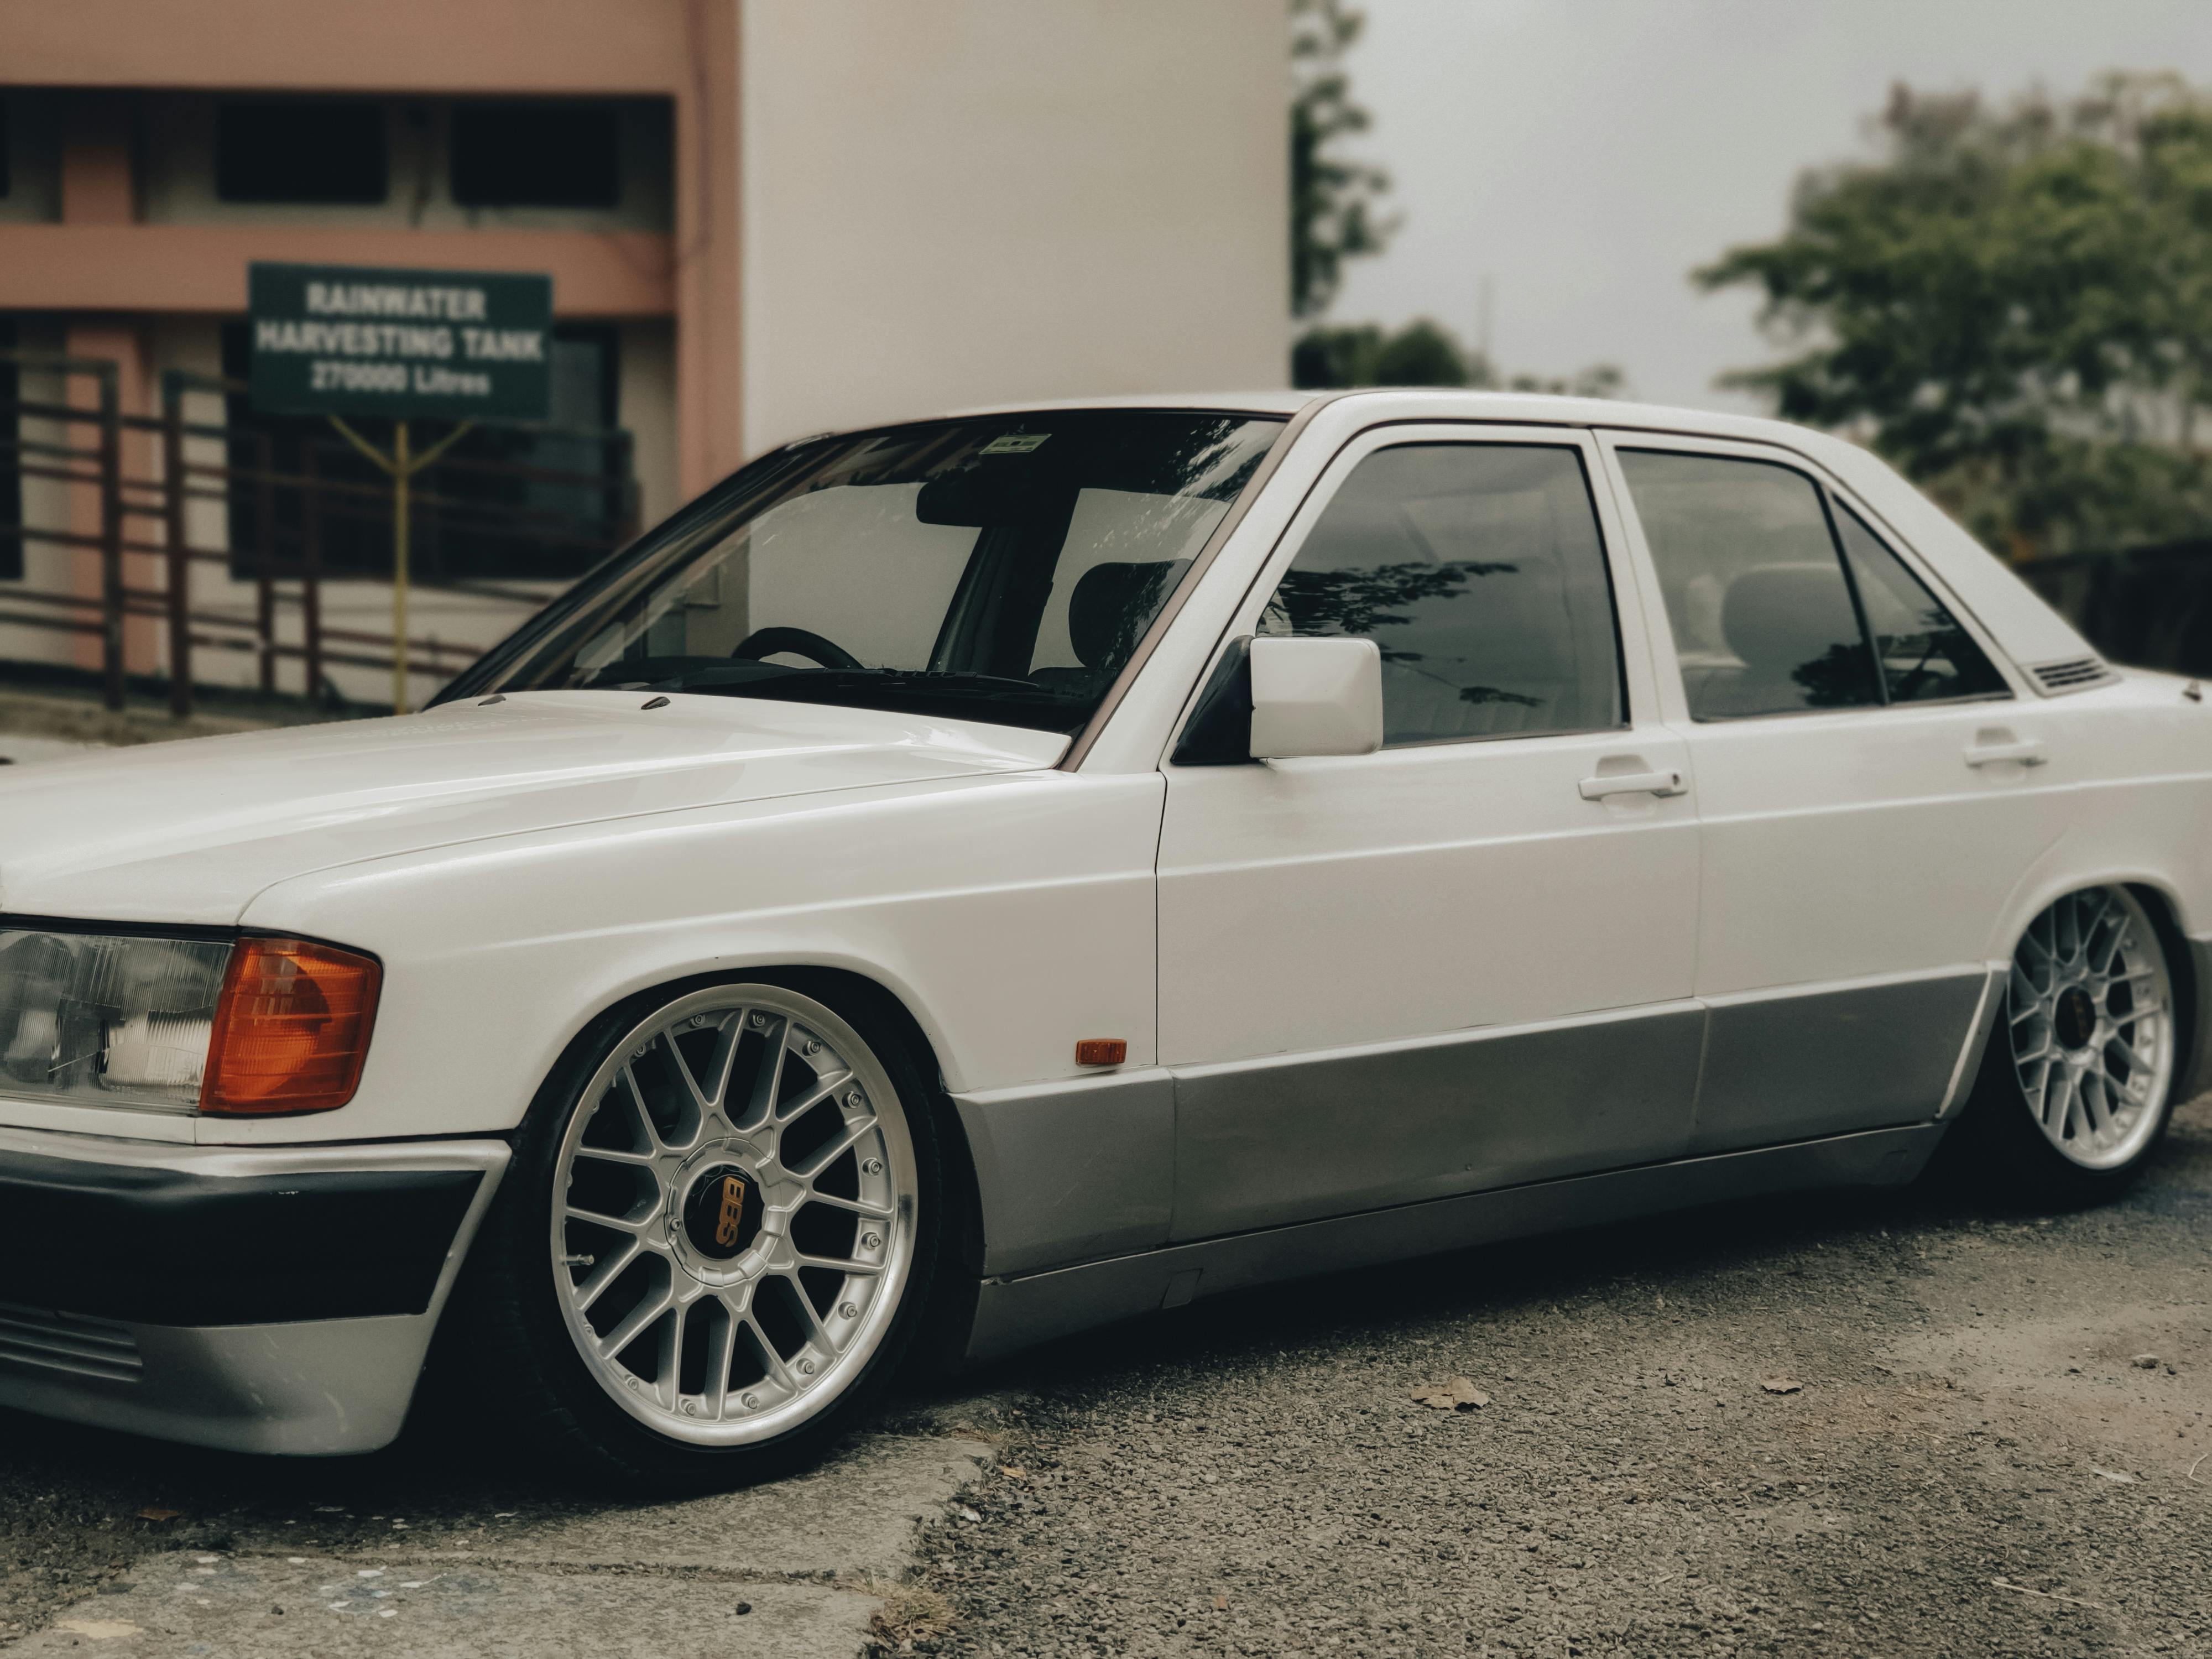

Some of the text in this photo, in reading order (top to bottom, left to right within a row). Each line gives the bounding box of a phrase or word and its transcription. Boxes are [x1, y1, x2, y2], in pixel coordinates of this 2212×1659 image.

[306, 283, 486, 320] RAINWATER
[255, 320, 544, 361] HARVESTING TANK
[414, 366, 491, 395] Litres
[716, 1176, 745, 1248] BBS
